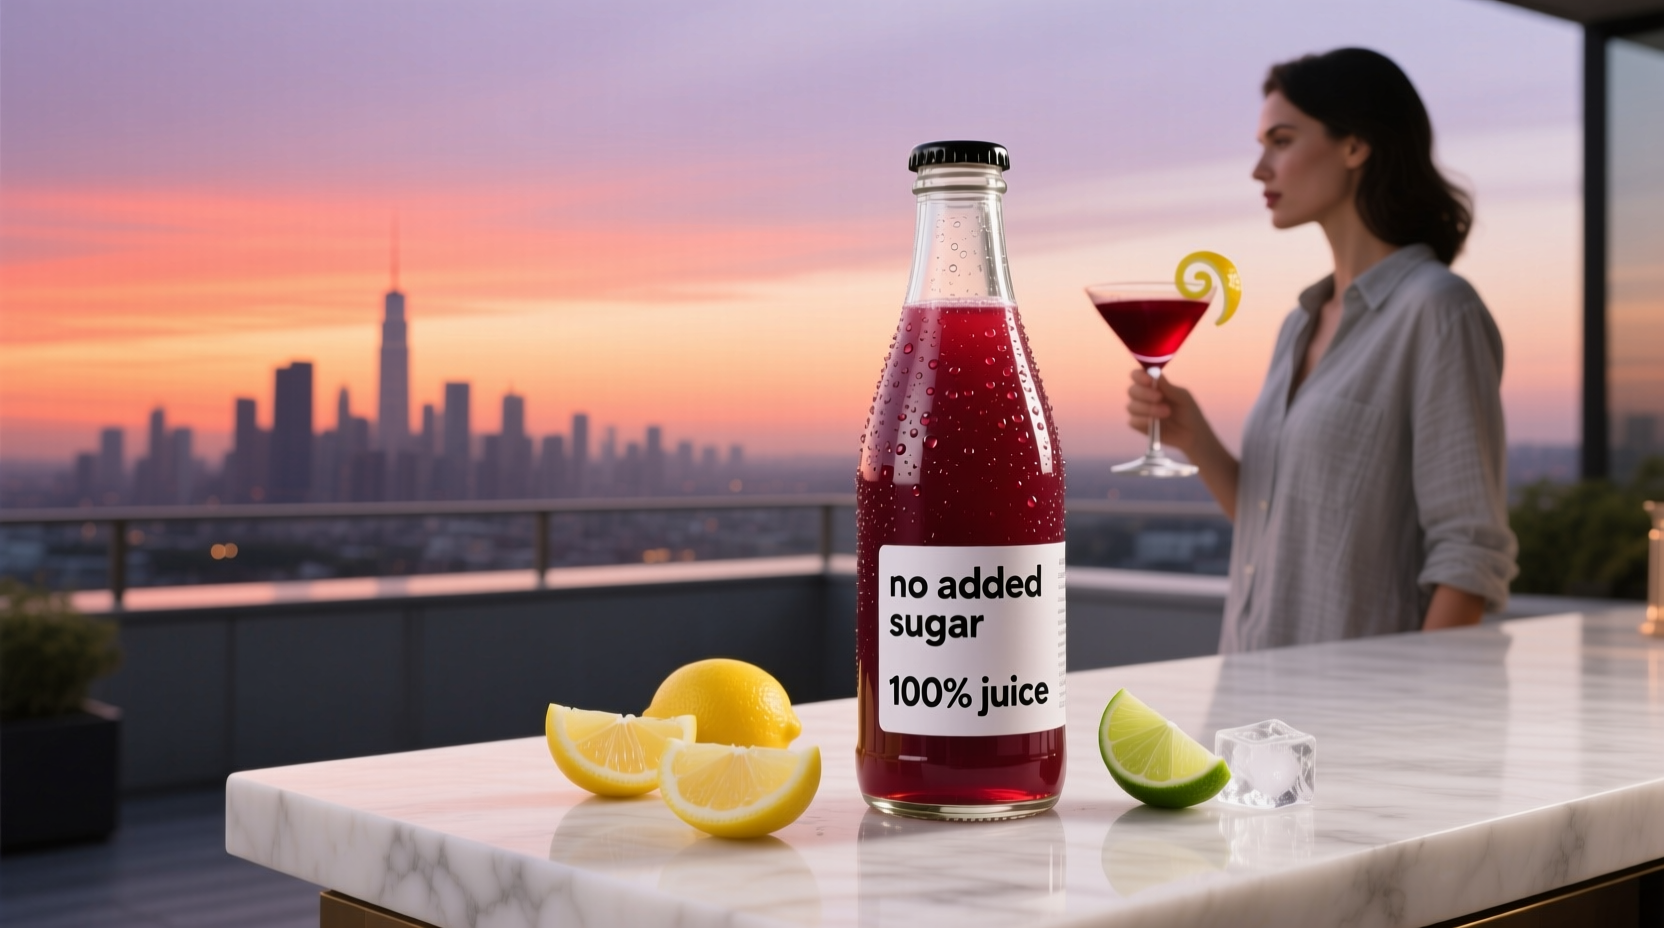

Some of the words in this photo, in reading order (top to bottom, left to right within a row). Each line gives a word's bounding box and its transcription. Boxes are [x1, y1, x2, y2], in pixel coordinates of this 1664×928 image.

[890, 575, 929, 599] no
[937, 564, 1042, 600] added
[889, 613, 985, 647] sugar
[889, 675, 973, 709] 100%
[977, 674, 1049, 717] juice
